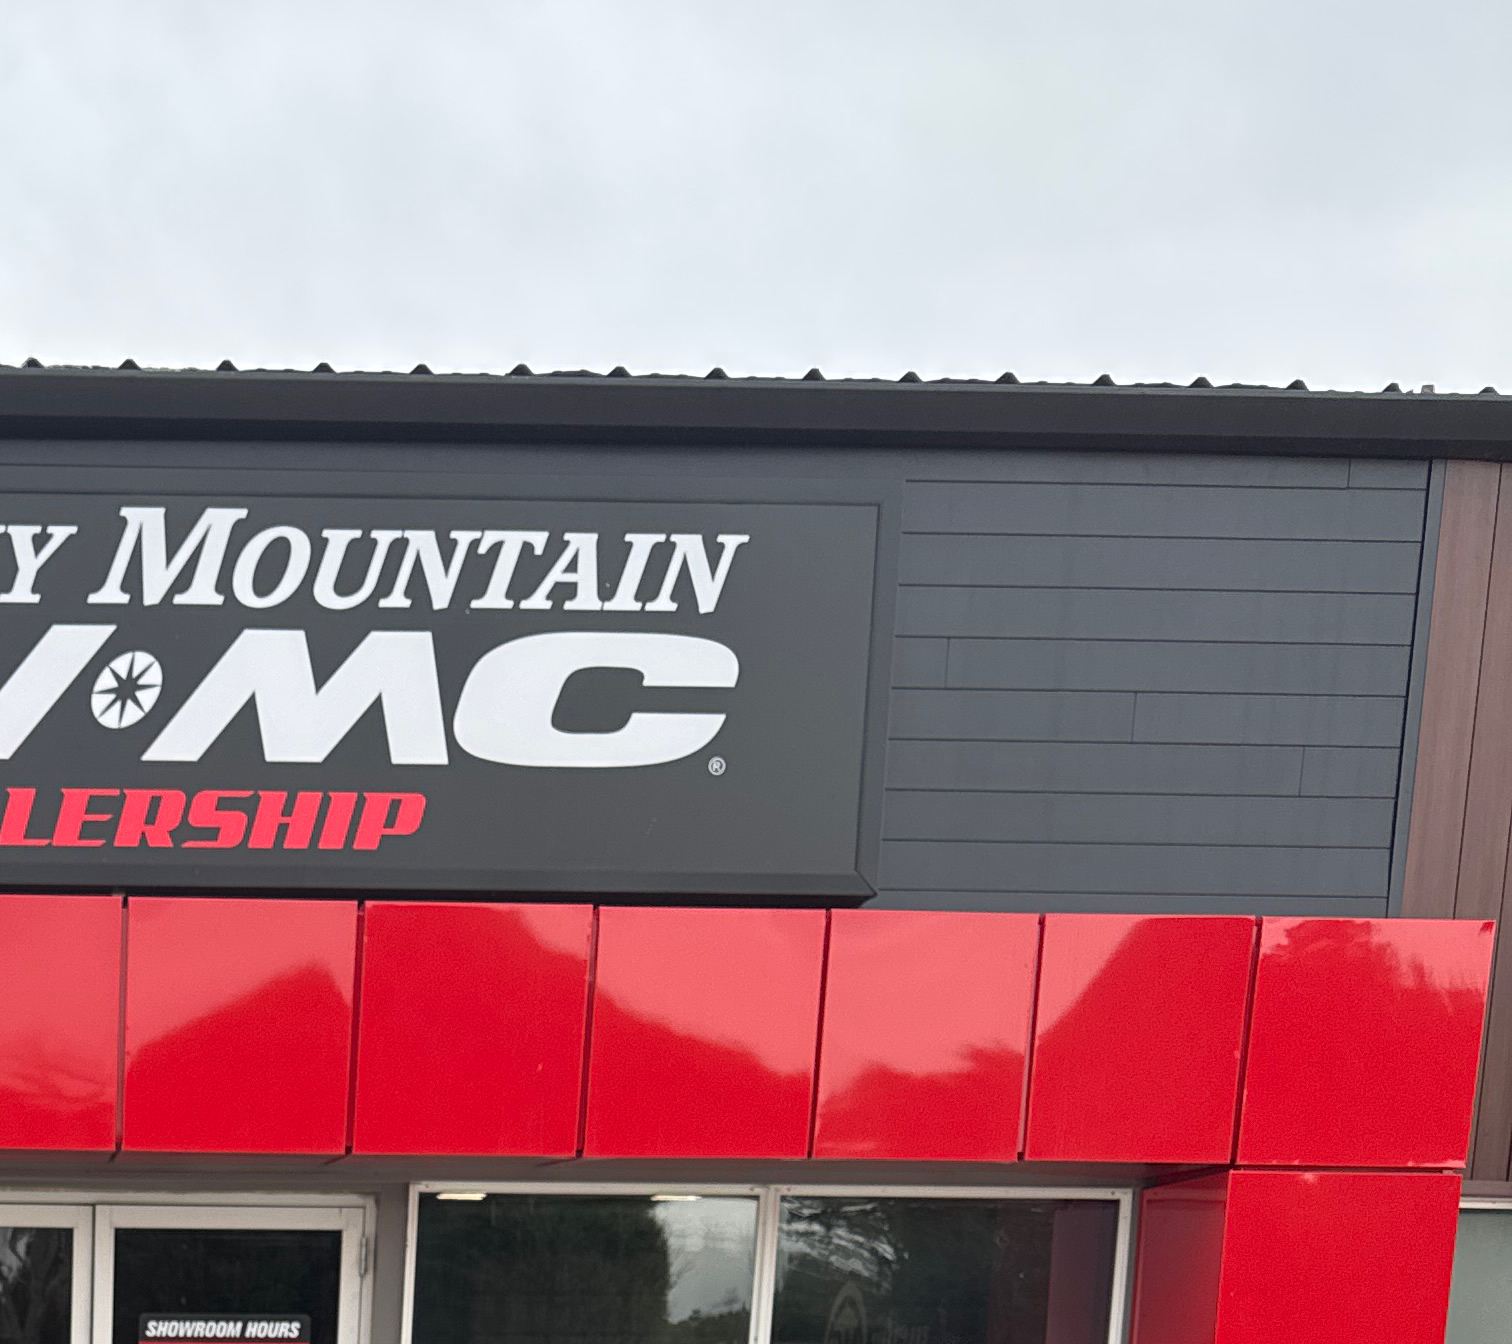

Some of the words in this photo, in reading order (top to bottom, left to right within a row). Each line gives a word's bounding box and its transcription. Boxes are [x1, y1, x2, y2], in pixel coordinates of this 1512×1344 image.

[86, 507, 751, 615] MOUNTAIN
[145, 1320, 243, 1338] SHOWROOM
[244, 1321, 301, 1339] HOURS
